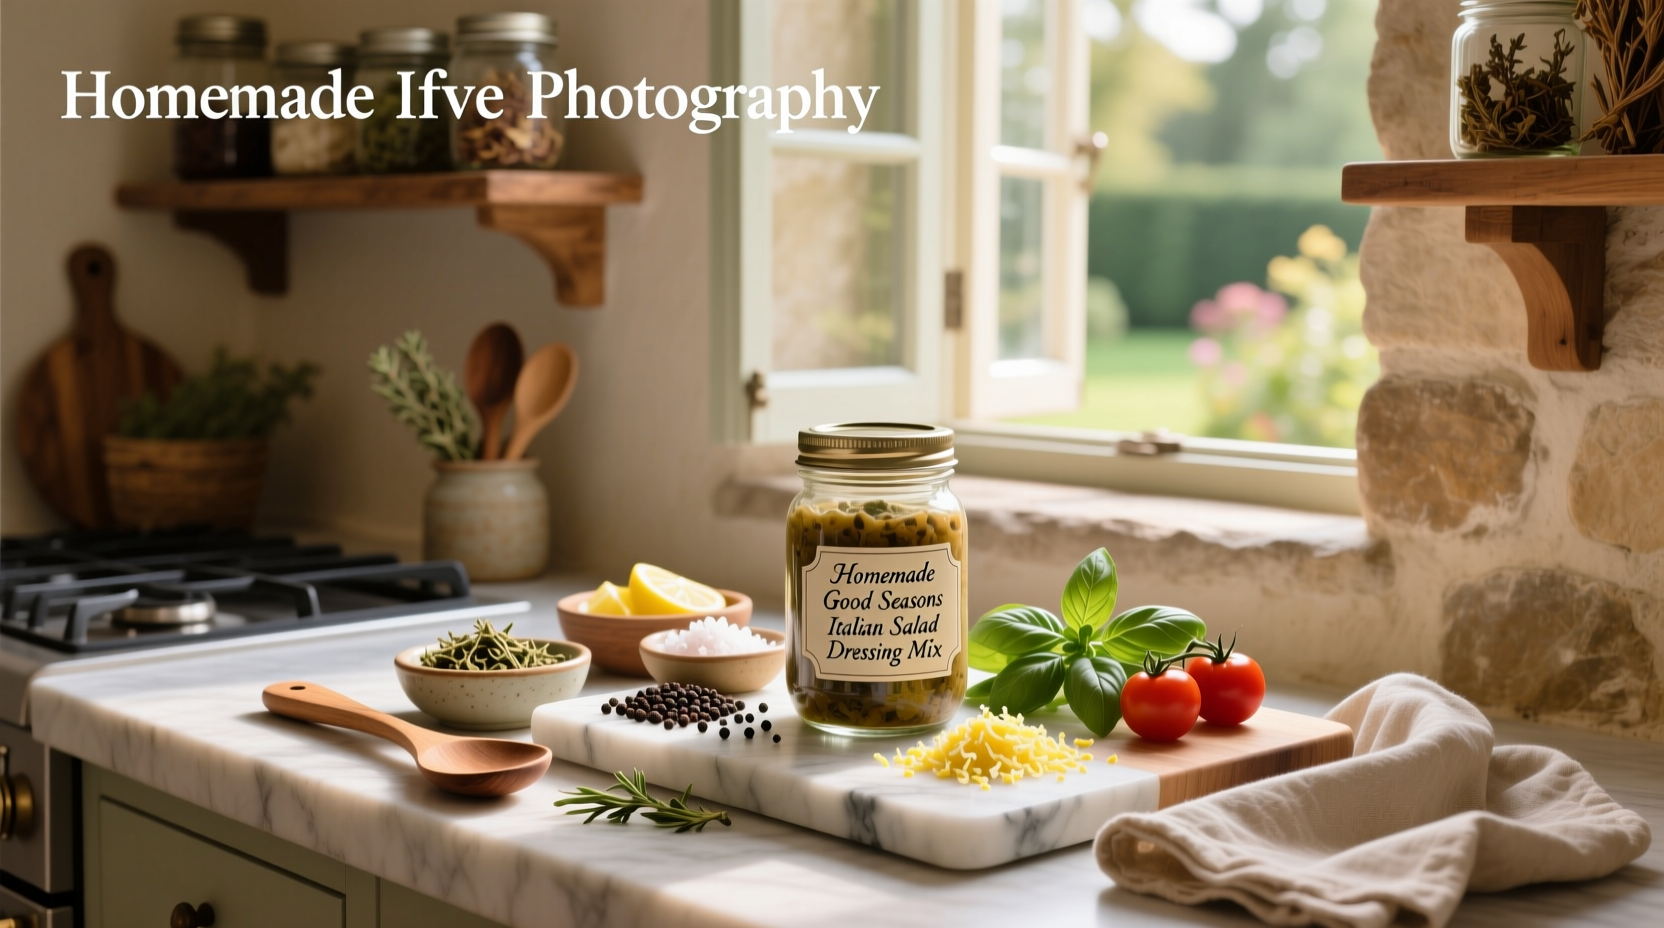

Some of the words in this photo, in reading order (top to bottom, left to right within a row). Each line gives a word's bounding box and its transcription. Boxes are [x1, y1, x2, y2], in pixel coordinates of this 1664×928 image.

[829, 561, 935, 585] Homemade
[823, 589, 875, 610] Good
[877, 590, 944, 610] Seasons
[827, 616, 884, 636] Italian
[889, 613, 940, 636] Salad
[826, 640, 903, 667] Dressing
[907, 638, 943, 660] Mix
